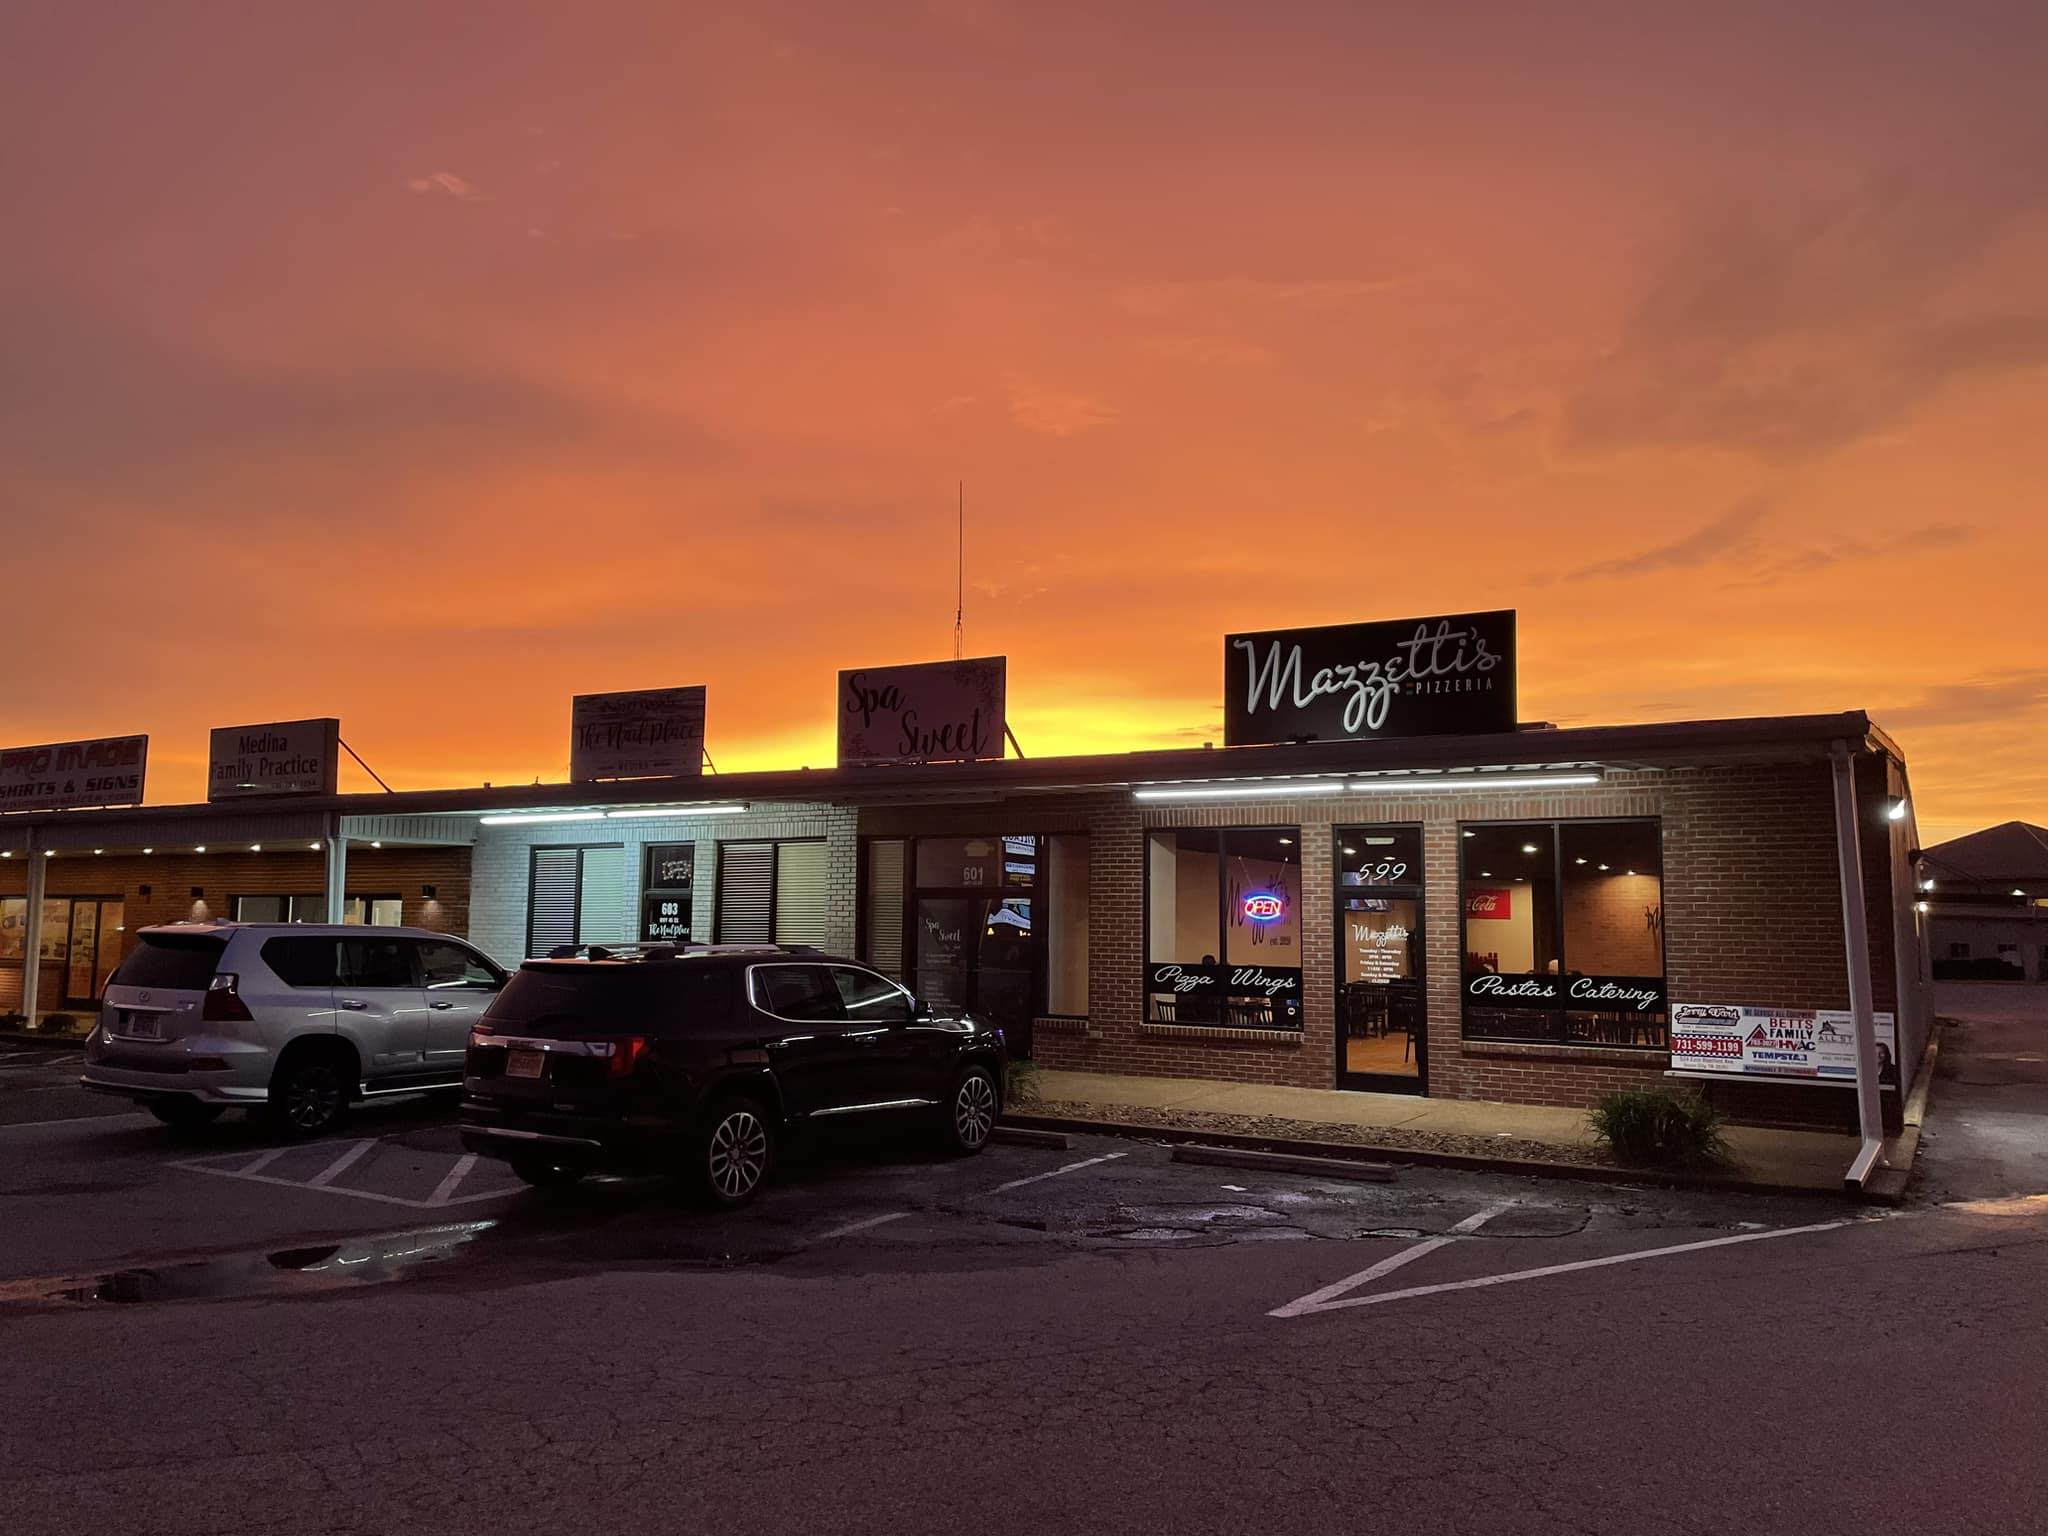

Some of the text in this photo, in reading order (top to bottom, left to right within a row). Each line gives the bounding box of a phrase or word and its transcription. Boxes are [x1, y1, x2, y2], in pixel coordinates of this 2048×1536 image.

[1234, 620, 1502, 733] Mazzetti's
[1415, 677, 1493, 695] PIZZERIA
[847, 673, 905, 728] Spa
[900, 708, 988, 757] Sweet
[238, 733, 287, 755] Medina
[211, 755, 318, 782] Family Practice
[63, 779, 75, 793] &
[85, 775, 139, 793] SIGNS
[963, 867, 984, 881] 601
[1356, 863, 1407, 881] 599
[662, 902, 679, 916] 603
[1245, 900, 1281, 915] OPEN
[1154, 965, 1215, 992] Pizza
[1230, 968, 1297, 996] Wings
[1470, 975, 1556, 999] Pastas
[1570, 978, 1659, 1011] Catering
[1770, 1018, 1814, 1029] BETTS
[1770, 1028, 1814, 1039] FAMILY
[1676, 1039, 1739, 1053] 731-599-1199
[1778, 1039, 1816, 1051] HVAC
